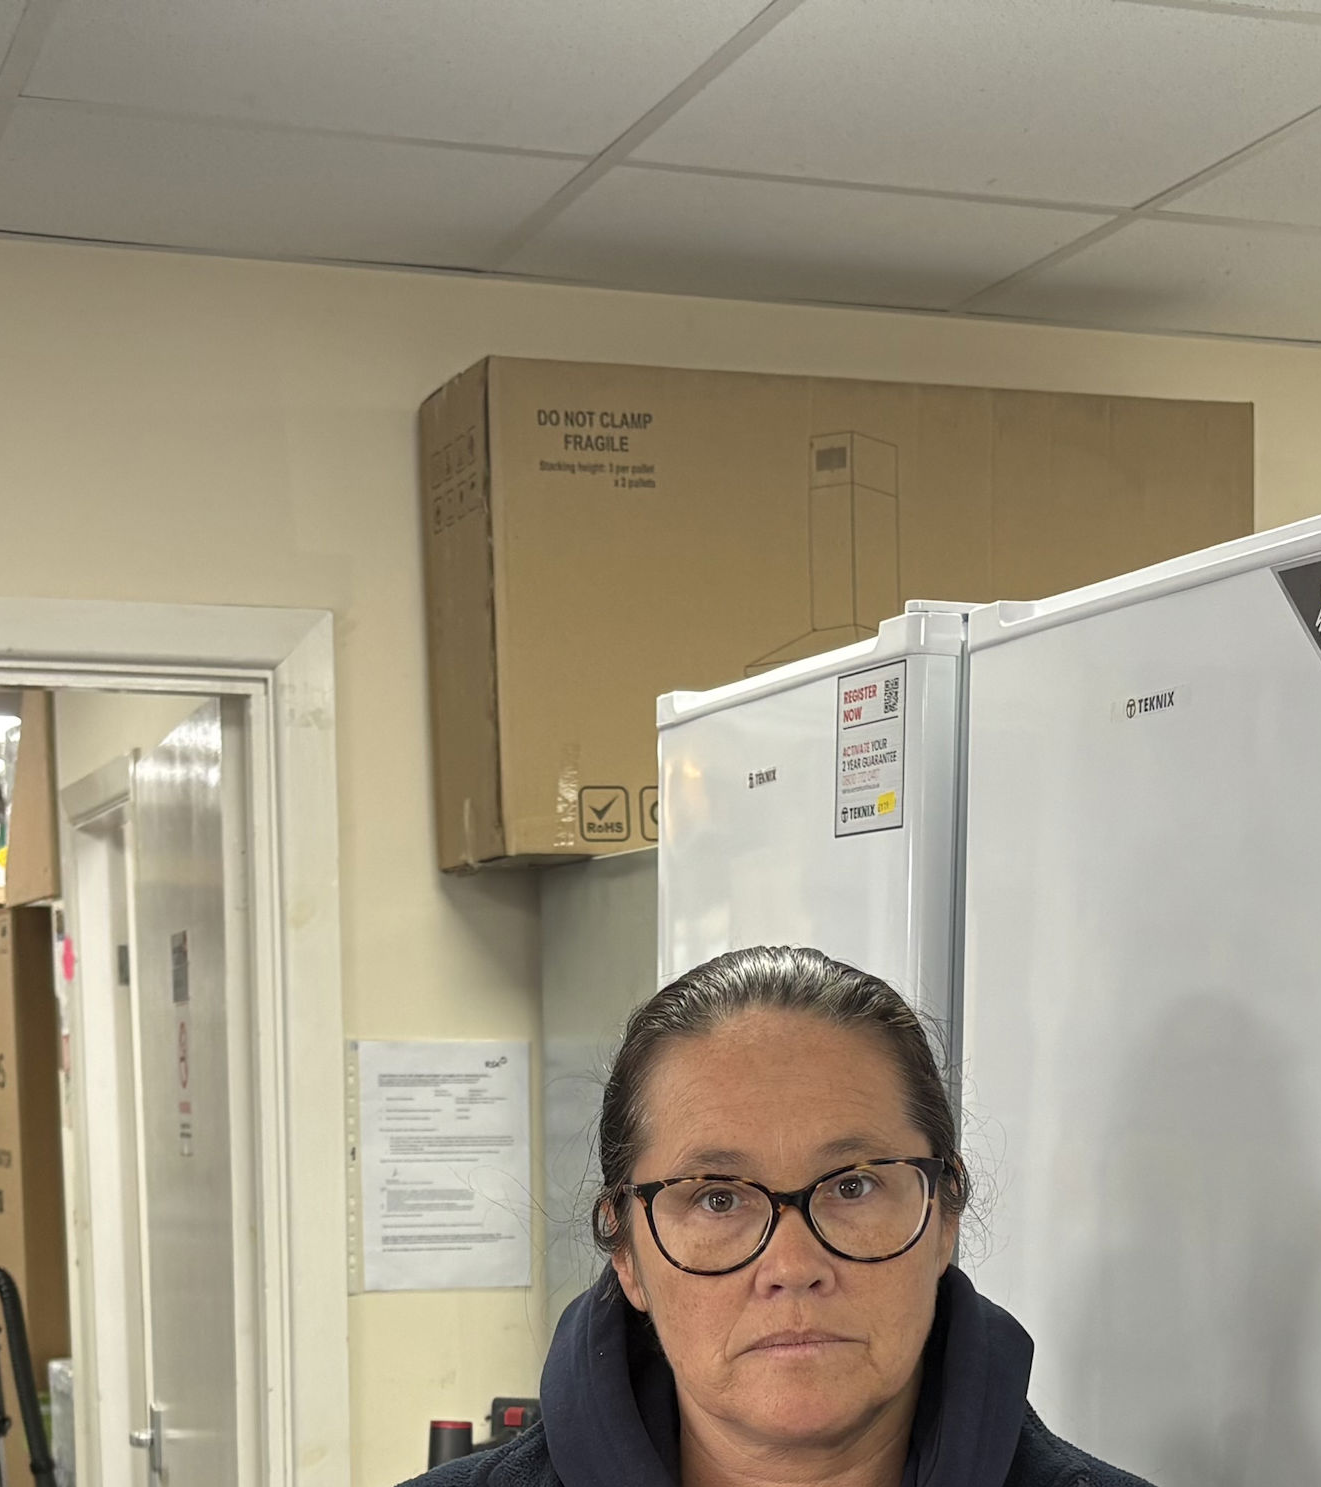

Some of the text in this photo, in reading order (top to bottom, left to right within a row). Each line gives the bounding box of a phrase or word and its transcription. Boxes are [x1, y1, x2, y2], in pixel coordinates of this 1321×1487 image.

[536, 409, 653, 430] DO NOT CLAMP
[564, 433, 630, 453] FRAGILE
[843, 684, 878, 705] REGISTER
[1138, 691, 1175, 714] TEKNIX
[843, 706, 863, 723] NOW
[871, 738, 888, 752] YOUR
[847, 758, 861, 771] YEAR
[862, 750, 898, 769] GUARANTEE
[755, 769, 777, 786] TEKNIX
[849, 804, 876, 820] TEKNIX
[586, 822, 623, 833] RoHS
